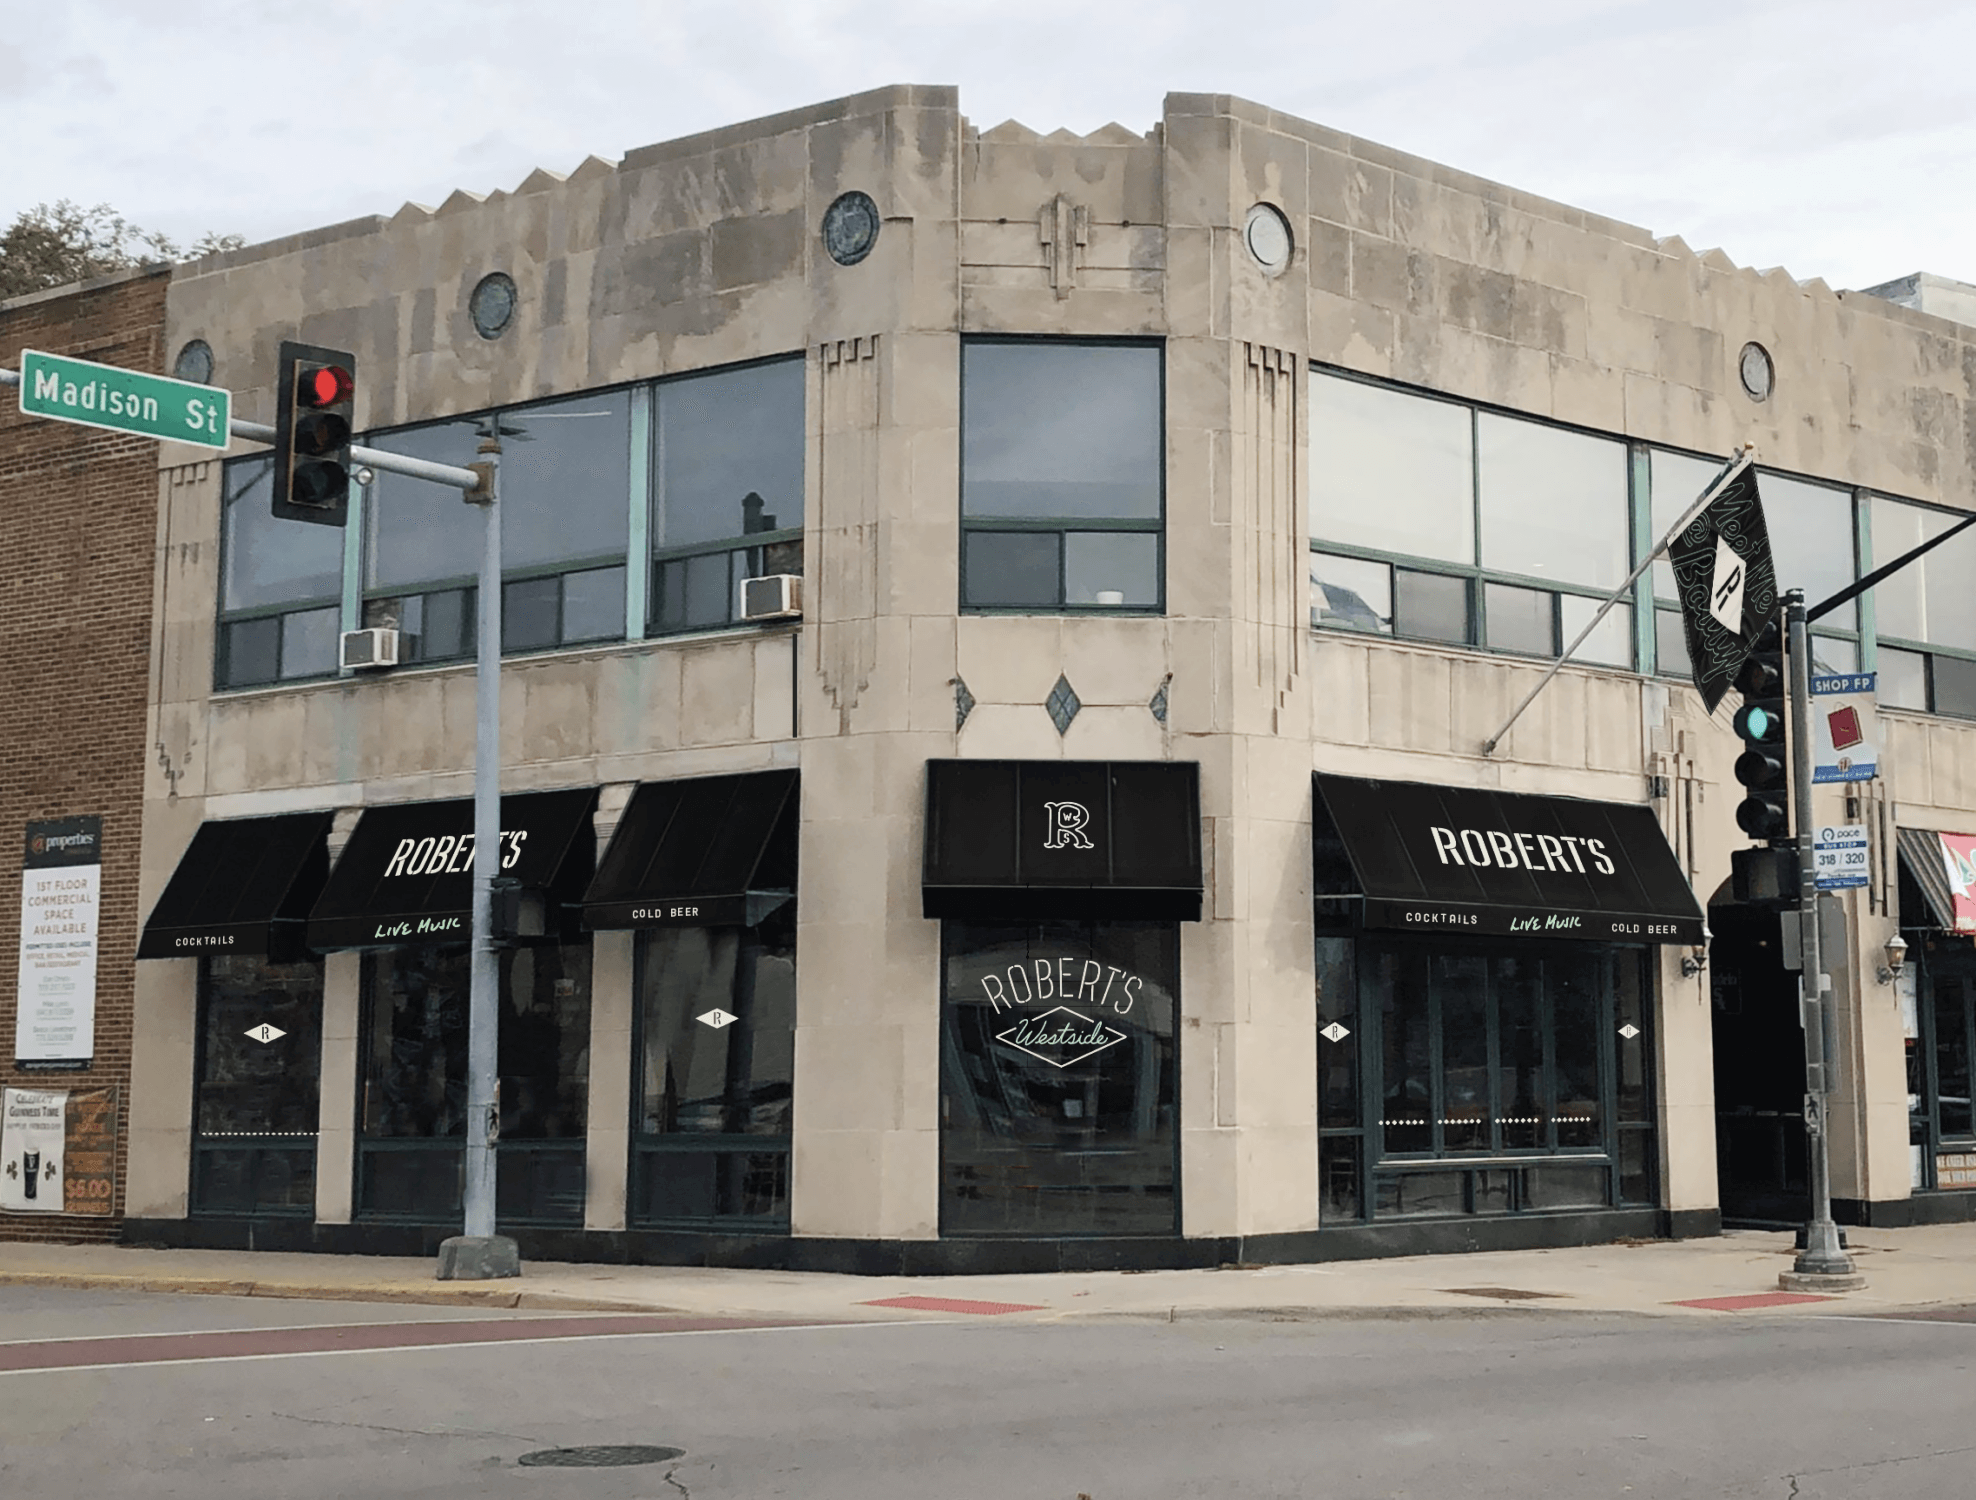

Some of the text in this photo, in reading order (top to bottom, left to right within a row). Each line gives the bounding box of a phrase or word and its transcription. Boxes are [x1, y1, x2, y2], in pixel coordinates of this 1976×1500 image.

[34, 369, 218, 434] Madison St
[1815, 677, 1871, 692] SHOP FP
[1043, 801, 1095, 849] R
[1837, 829, 1860, 839] pace
[384, 829, 528, 878] ROBE'S
[1430, 826, 1616, 875] ROBERT'S
[1818, 853, 1837, 866] 318
[1845, 852, 1865, 864] 320
[54, 878, 88, 891] FLOOR
[27, 894, 92, 907] COMMERCIAL
[44, 908, 75, 920] SPACE
[632, 906, 699, 919] COLD BEER
[1405, 912, 1478, 926] COCKTAILS
[33, 922, 87, 935] AVAILABLE
[374, 921, 413, 939] LIVE
[1509, 916, 1542, 932] LIVE
[1611, 923, 1678, 935] COLD BEER
[175, 935, 234, 947] COCKTAILS
[981, 957, 1143, 1014] ROBERT'S
[713, 1011, 722, 1025] R
[261, 1026, 270, 1040] R
[1015, 1018, 1109, 1046] Westside
[1332, 1025, 1339, 1039] R
